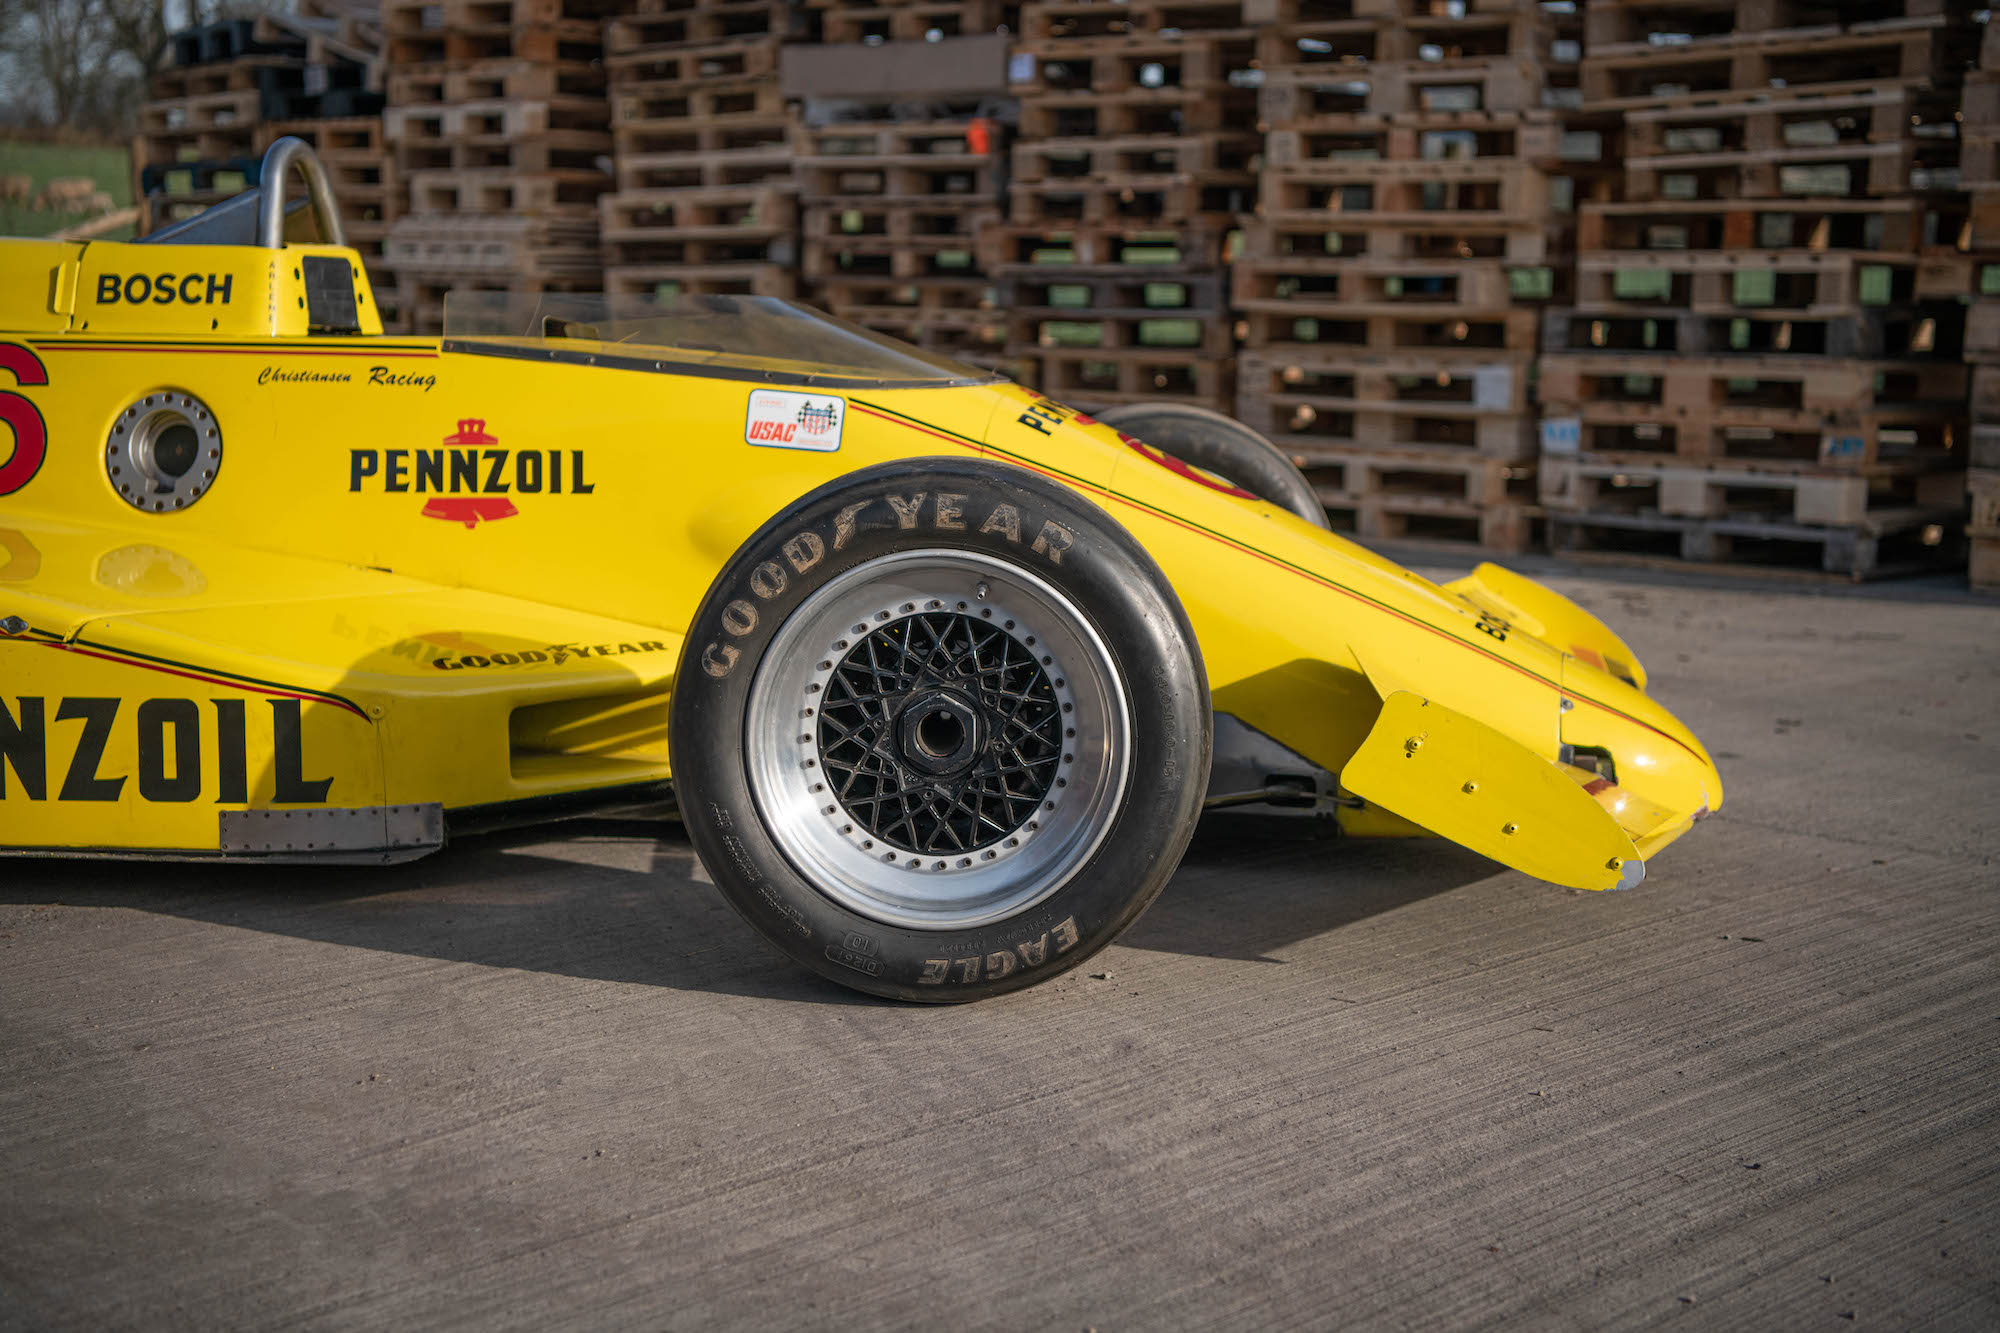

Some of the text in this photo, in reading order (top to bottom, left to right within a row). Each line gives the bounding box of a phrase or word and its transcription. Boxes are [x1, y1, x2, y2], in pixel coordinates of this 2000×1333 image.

[96, 272, 233, 305] BOSCH
[257, 365, 437, 392] Christiansen Racing
[748, 420, 797, 443] USAC
[348, 448, 596, 494] PENNZOIL
[916, 914, 1080, 985] EAGLE
